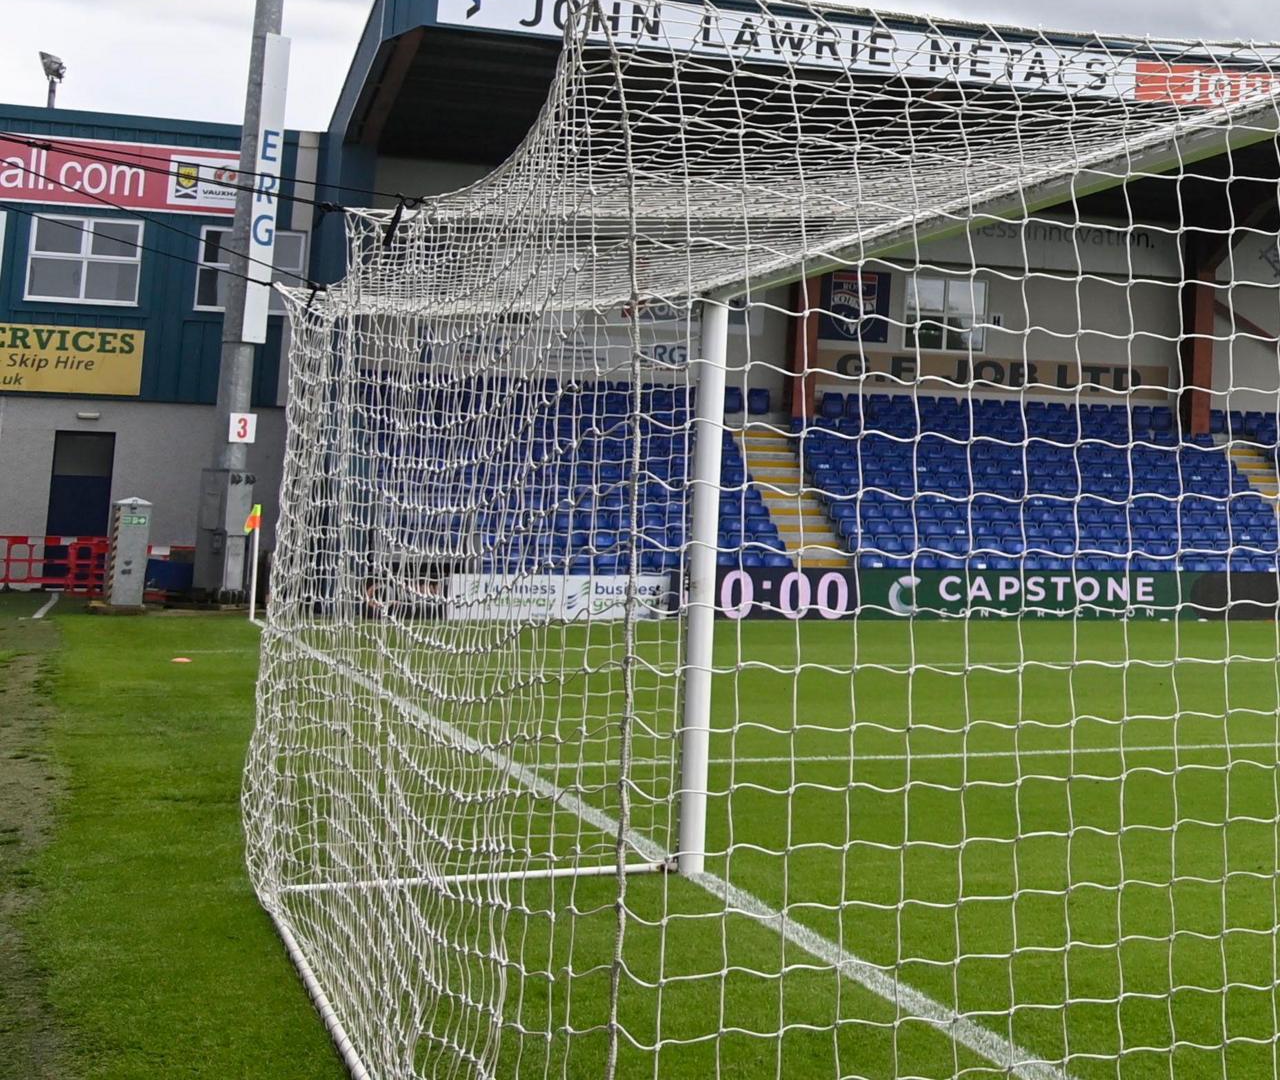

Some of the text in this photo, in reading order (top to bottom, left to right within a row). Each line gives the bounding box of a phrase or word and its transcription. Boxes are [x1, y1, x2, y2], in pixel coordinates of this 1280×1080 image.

[701, 14, 892, 68] LAWRIE
[928, 38, 1108, 91] METALS
[252, 129, 281, 248] ERG
[7, 353, 95, 371] Skip Hire
[954, 359, 1045, 388] JOB
[1056, 364, 1142, 394] LTD
[237, 418, 248, 439] 3
[938, 575, 1155, 602] CAPSTONE
